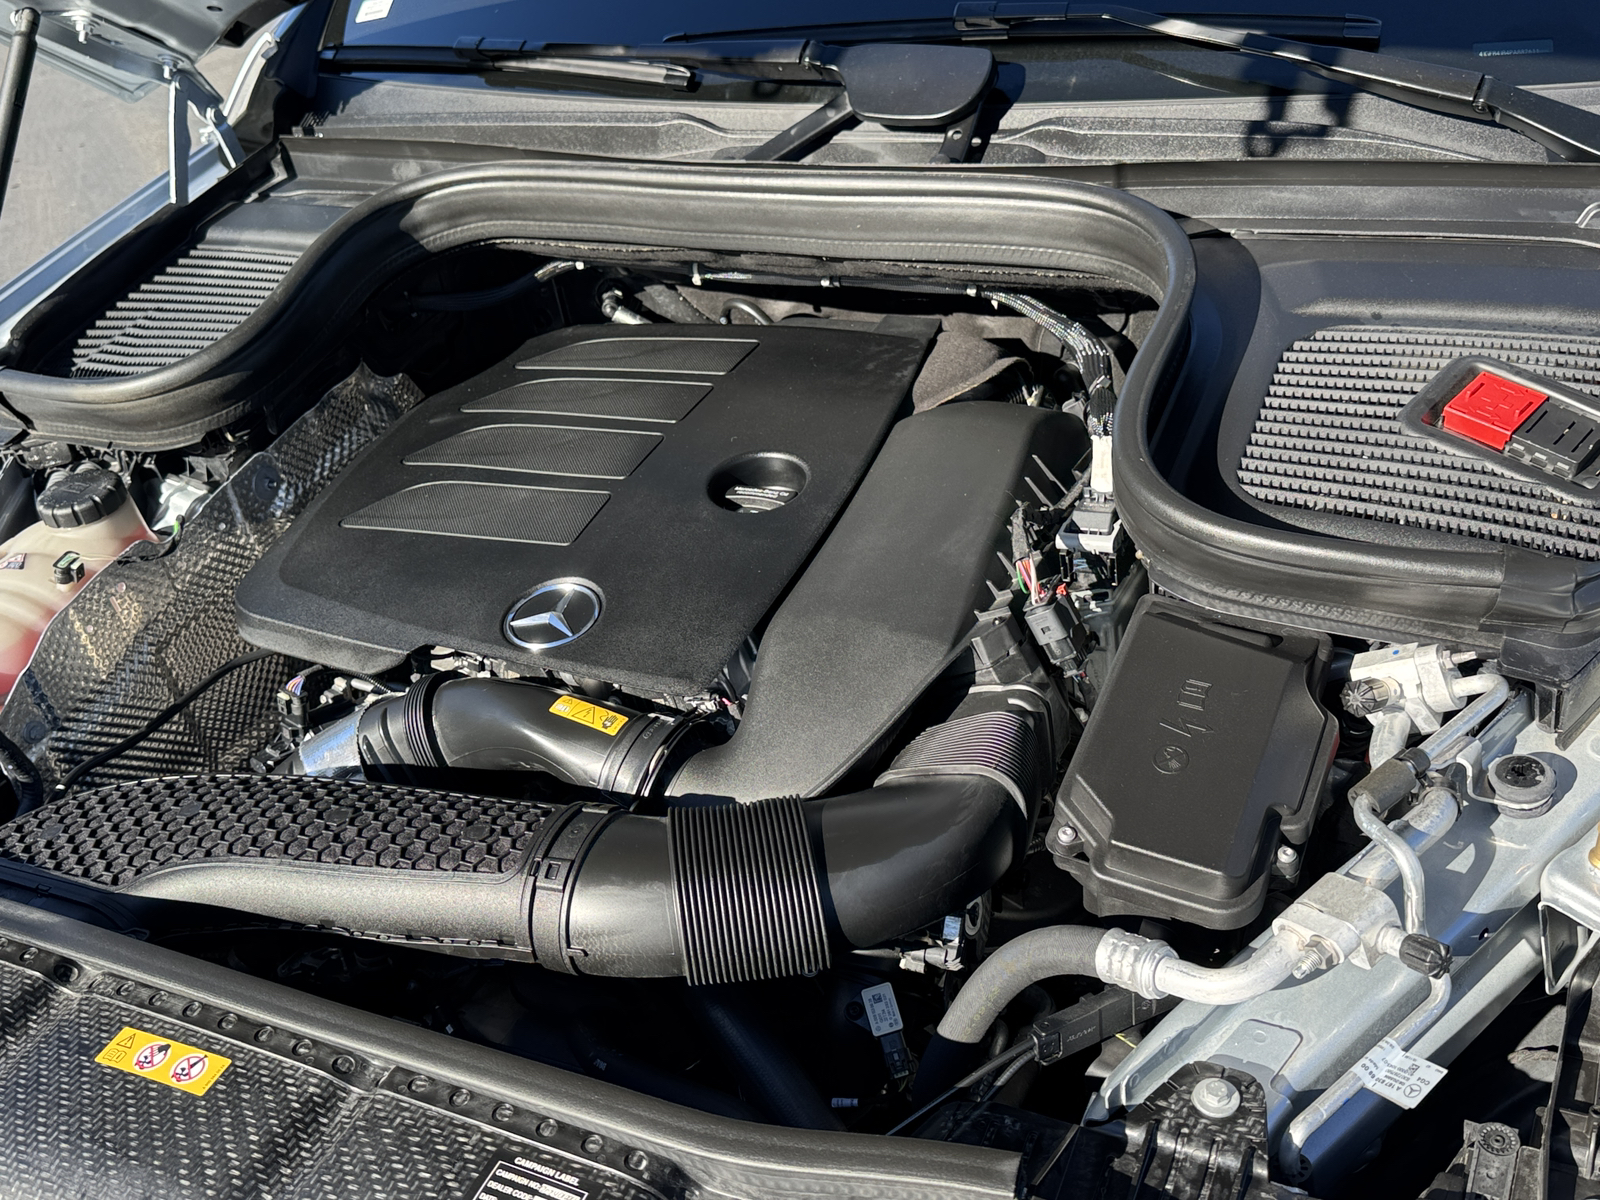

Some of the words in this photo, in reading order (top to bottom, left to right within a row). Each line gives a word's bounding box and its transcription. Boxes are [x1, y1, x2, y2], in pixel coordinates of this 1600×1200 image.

[495, 1169, 529, 1186] CAMPAIGN
[514, 1156, 555, 1177] CAMPAIGN
[554, 1171, 580, 1187] LABEL
[487, 1180, 514, 1195] DEALER
